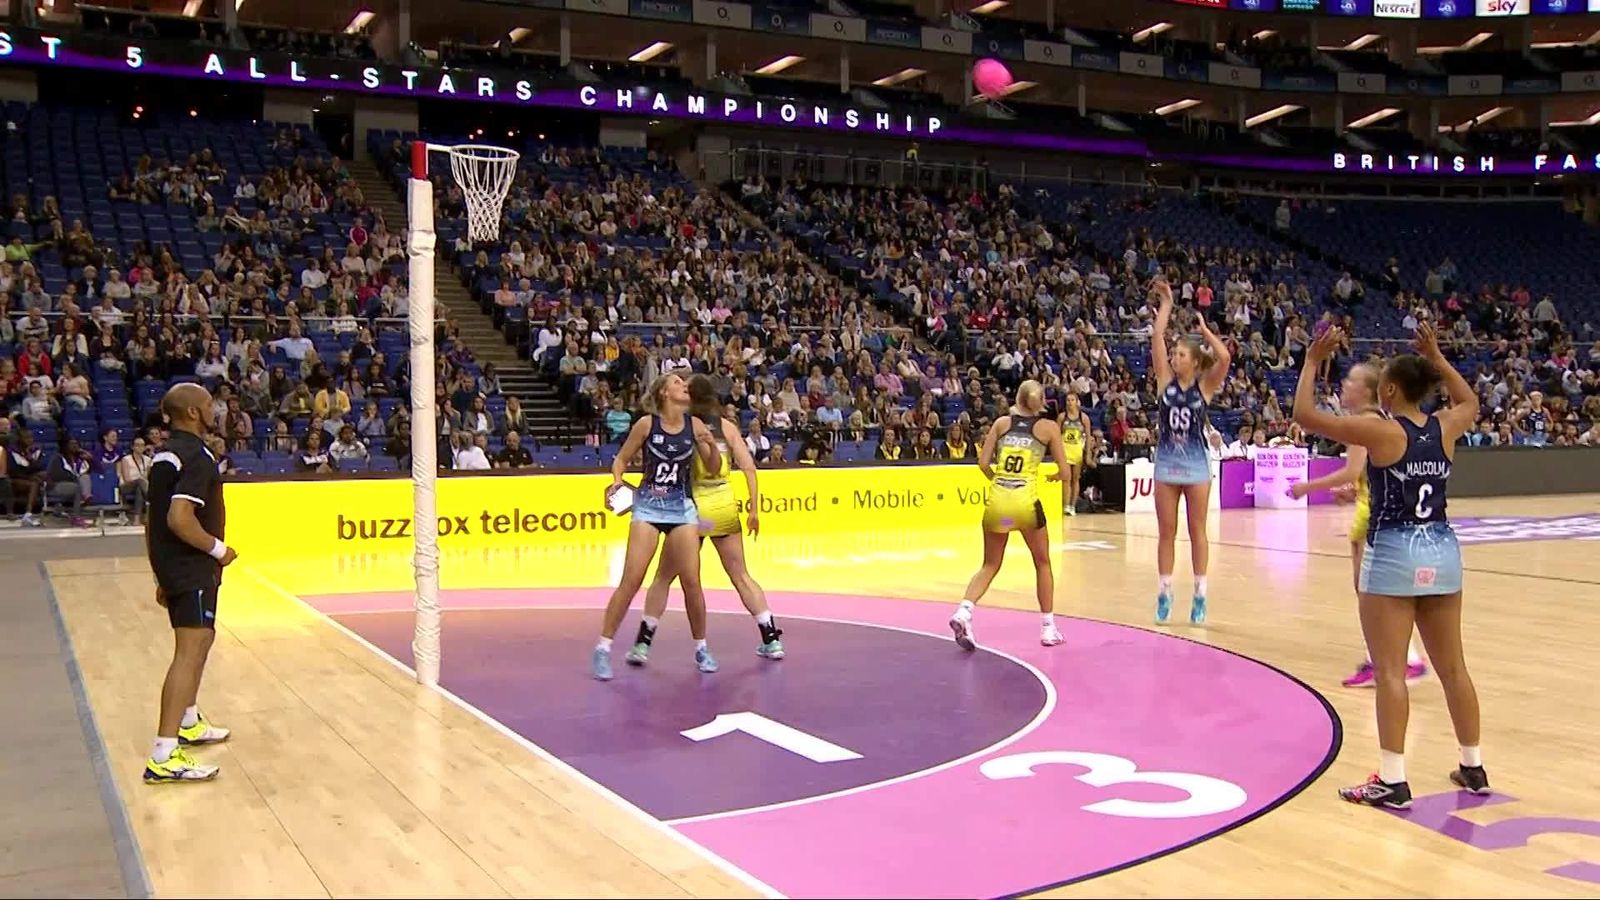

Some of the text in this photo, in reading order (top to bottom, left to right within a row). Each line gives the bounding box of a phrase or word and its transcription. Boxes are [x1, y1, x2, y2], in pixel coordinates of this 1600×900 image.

[126, 46, 142, 68] 5
[204, 54, 532, 100] ALL-STARS
[580, 86, 941, 133] CHAMPIONSHIP
[1333, 153, 1494, 172] BRITISH
[1169, 406, 1191, 430] GS
[1406, 460, 1446, 476] MALCOLM
[853, 489, 923, 509] Mobile
[1415, 483, 1433, 519] C
[337, 508, 607, 540] buzzox telecom
[680, 711, 864, 764] 1
[980, 750, 1248, 819] 3
